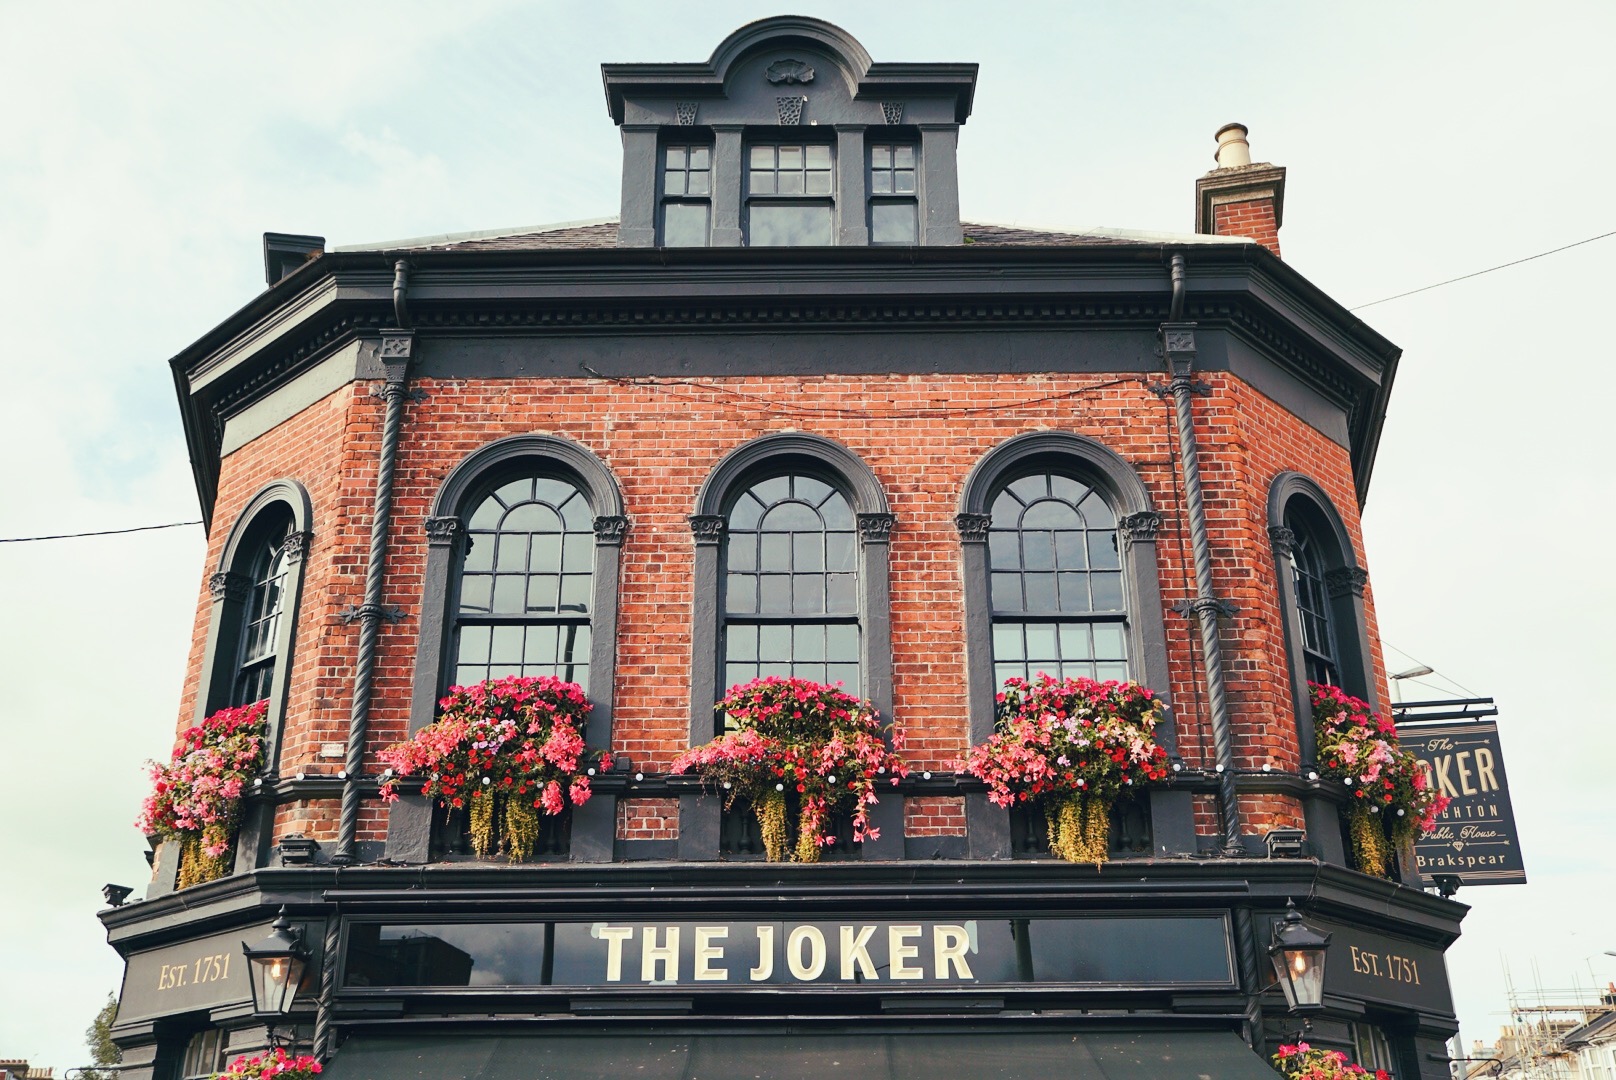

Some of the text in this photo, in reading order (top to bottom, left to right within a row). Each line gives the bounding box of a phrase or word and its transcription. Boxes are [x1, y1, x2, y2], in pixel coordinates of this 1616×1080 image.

[1427, 737, 1454, 751] The
[1415, 747, 1500, 802] OKER
[1419, 825, 1497, 841] Public House
[1415, 853, 1506, 868] Brakspear
[158, 952, 231, 991] EST. 1751
[599, 925, 974, 981] THE JOKER
[1350, 945, 1421, 985] EST. 1751
